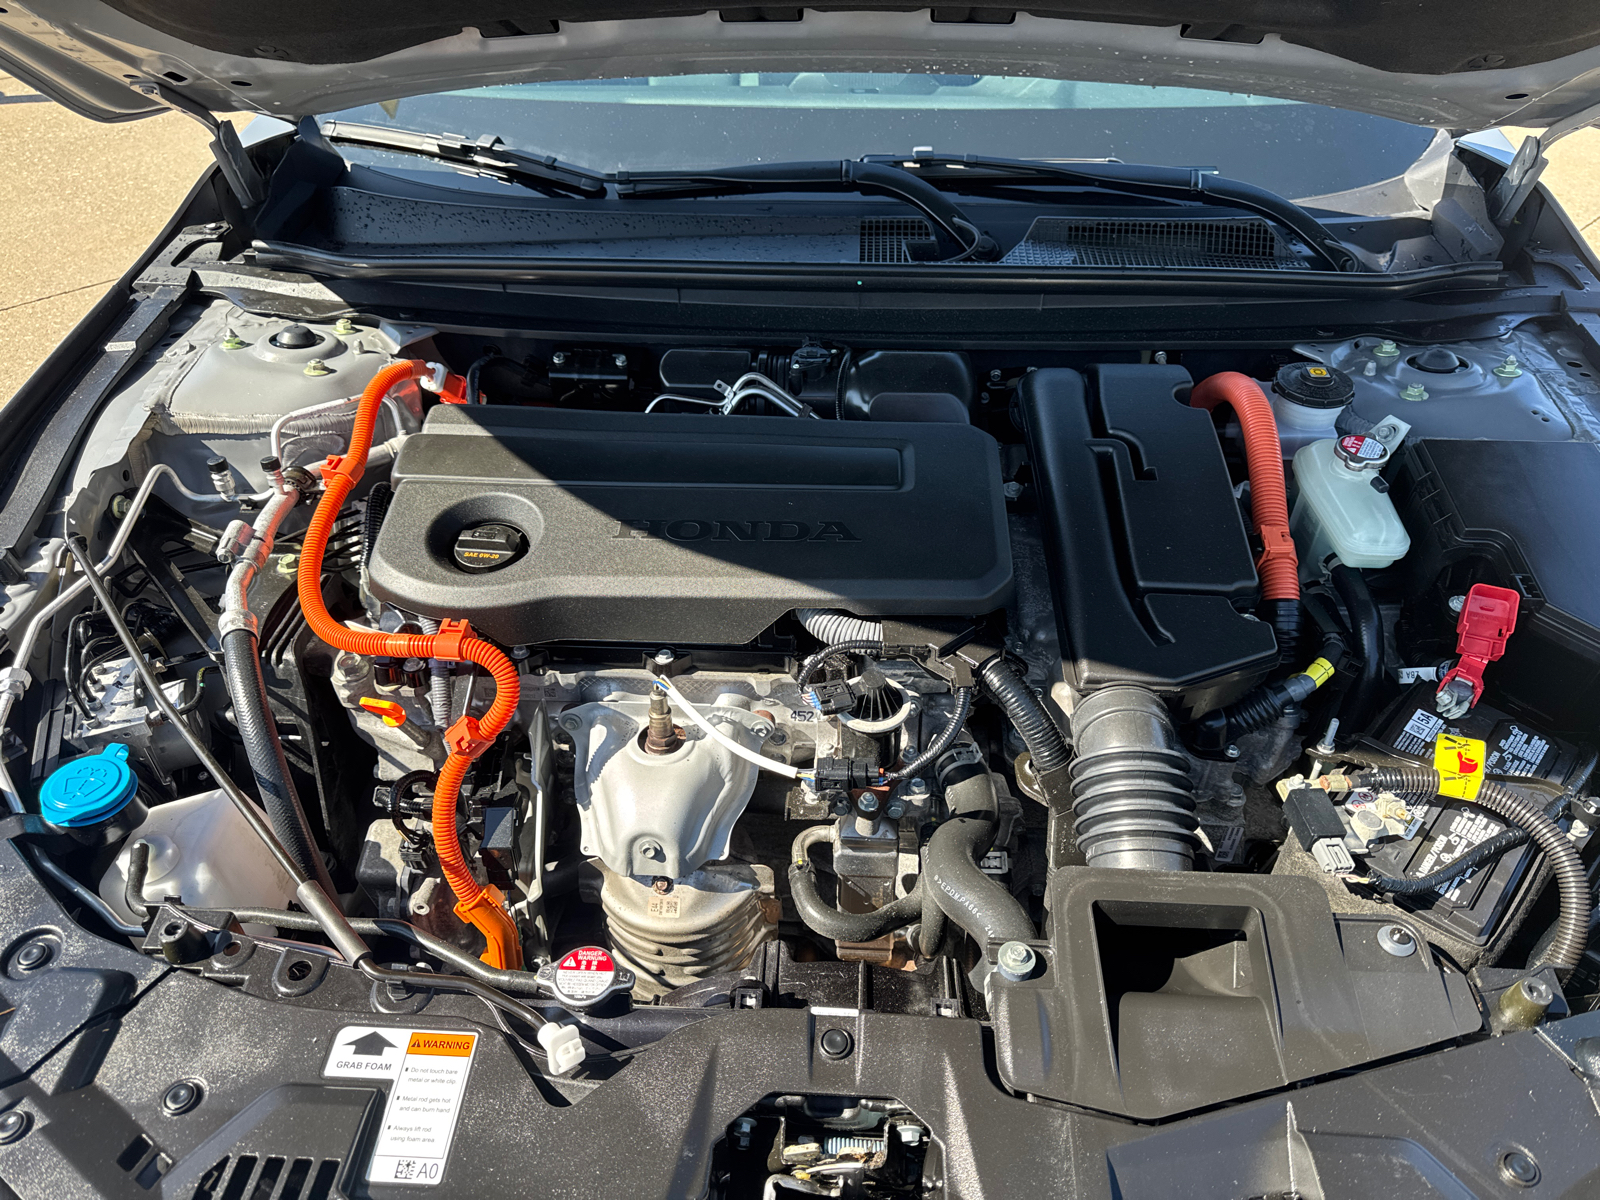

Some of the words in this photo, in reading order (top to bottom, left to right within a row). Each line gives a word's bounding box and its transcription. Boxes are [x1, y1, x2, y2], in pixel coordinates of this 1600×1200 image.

[611, 519, 863, 542] HONDA
[790, 710, 814, 722] 452
[1417, 712, 1433, 725] 5A
[423, 1040, 470, 1050] WARNING
[336, 1060, 362, 1070] GRAB
[365, 1062, 392, 1071] FOAM
[416, 1162, 439, 1180] A0
